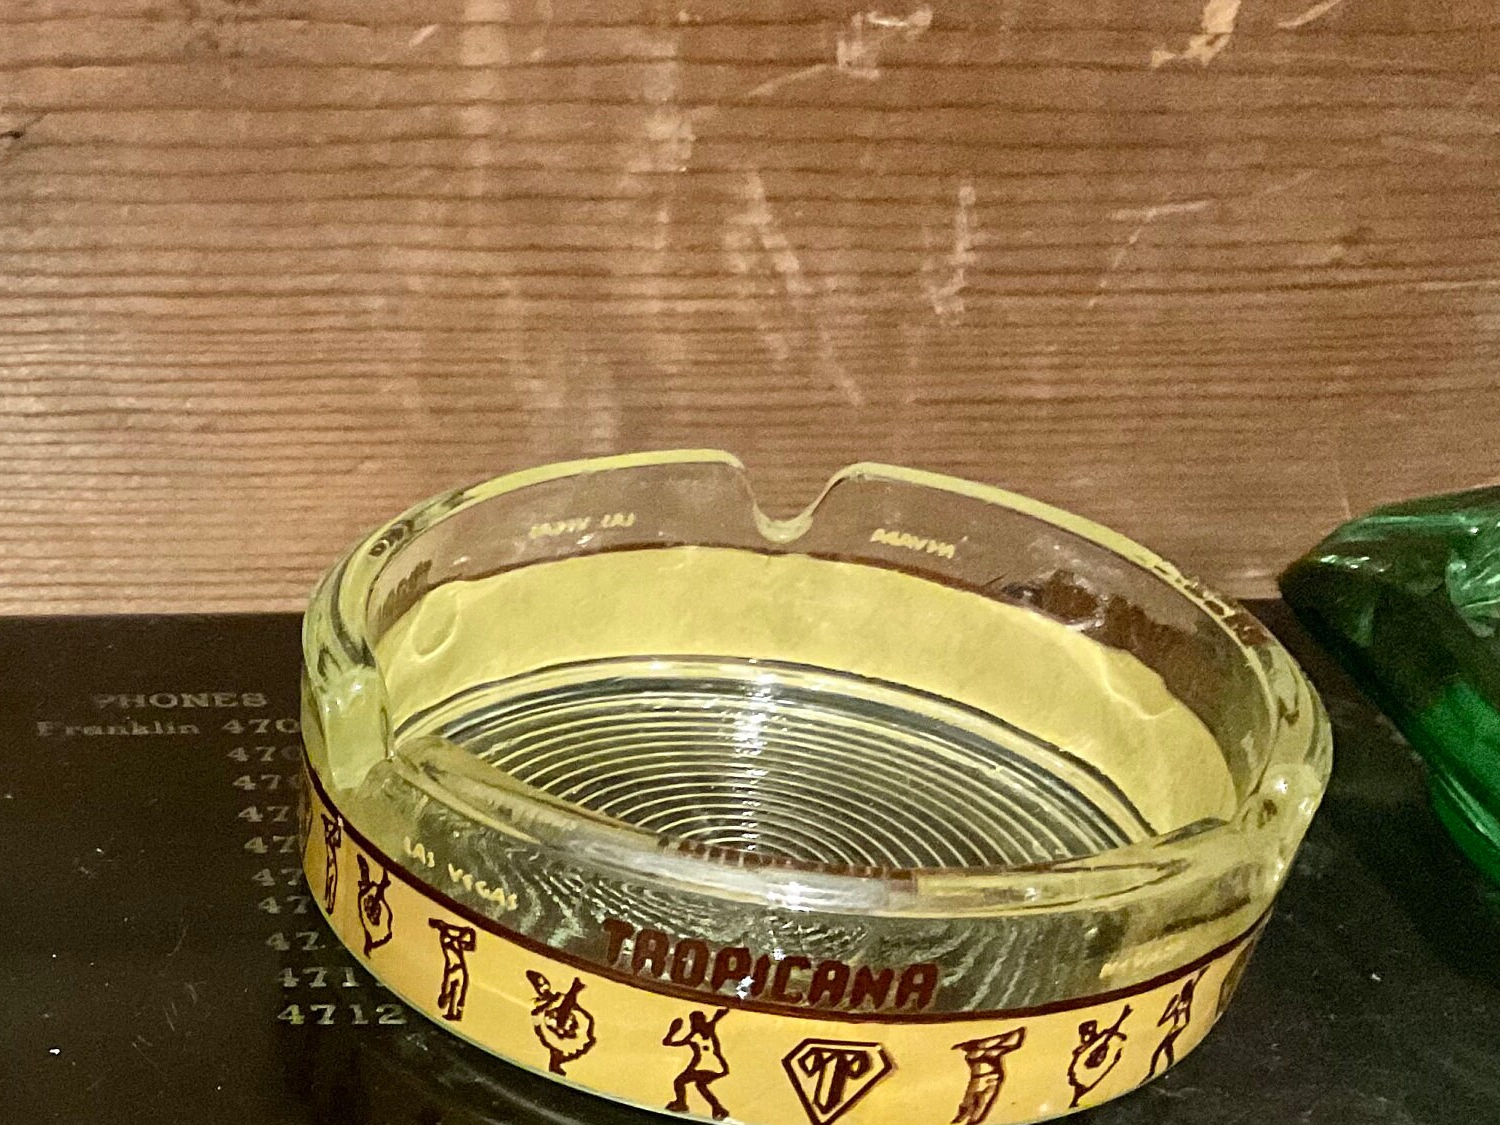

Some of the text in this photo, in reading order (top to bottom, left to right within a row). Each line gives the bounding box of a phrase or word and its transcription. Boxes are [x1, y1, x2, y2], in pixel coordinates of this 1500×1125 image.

[94, 691, 268, 709] PHONES
[37, 717, 300, 737] Franklin 470
[237, 805, 290, 823] 47
[244, 834, 297, 855] 47
[251, 868, 303, 887] 47
[257, 895, 312, 915] 47
[601, 916, 940, 1010] TROPICANA
[278, 966, 362, 988] 471
[276, 1003, 408, 1026] 4712
